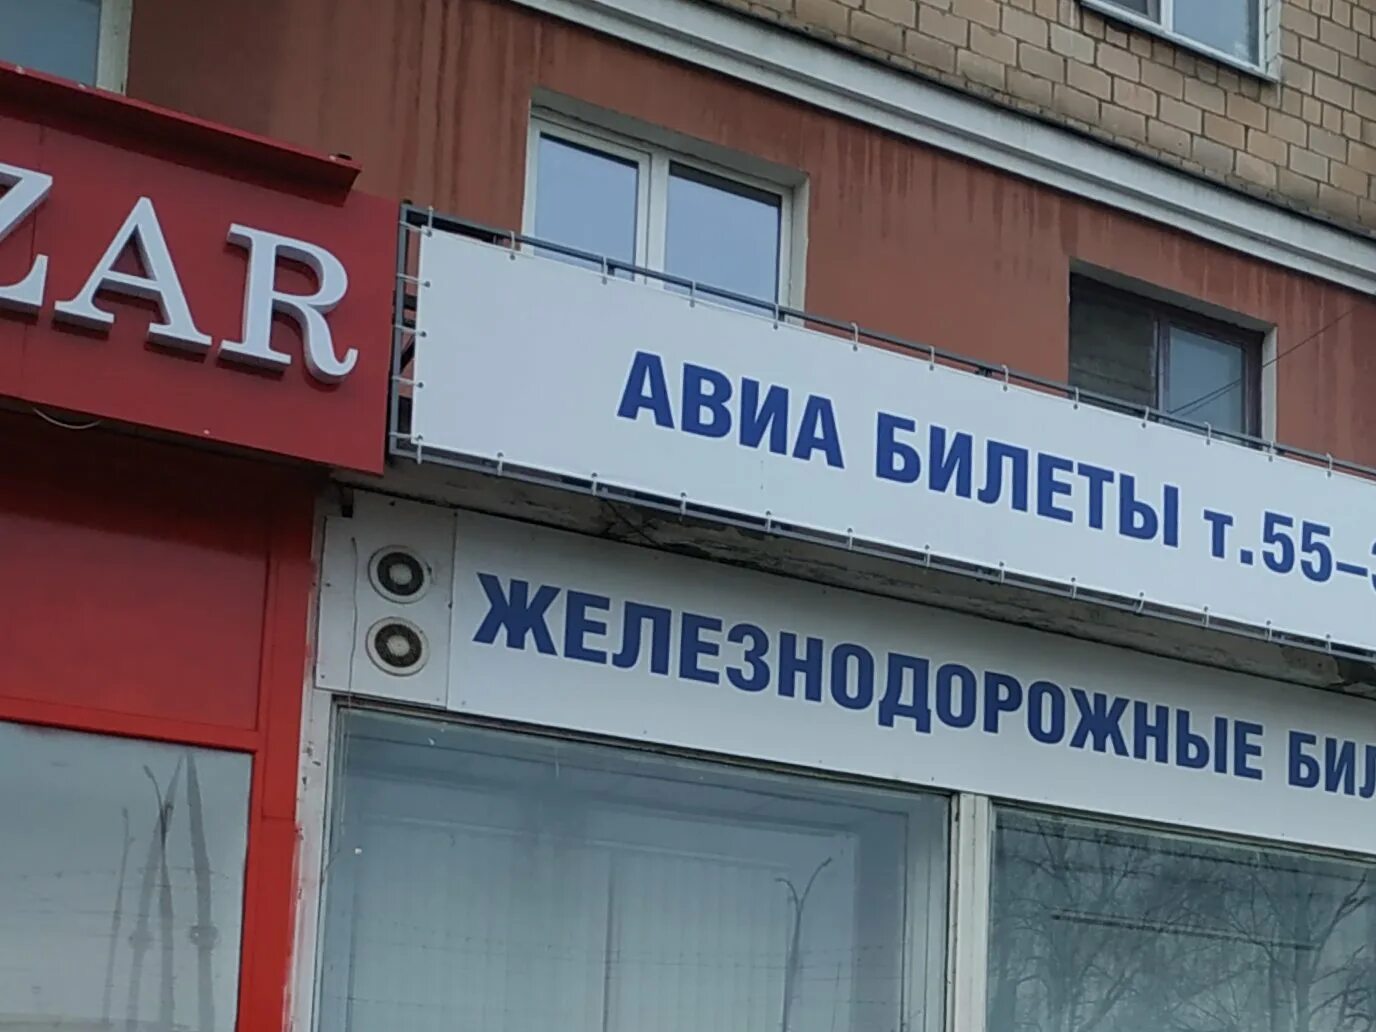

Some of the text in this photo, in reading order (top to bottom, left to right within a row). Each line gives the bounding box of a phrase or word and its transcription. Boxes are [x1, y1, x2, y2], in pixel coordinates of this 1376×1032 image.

[617, 350, 845, 470] АВИА
[875, 410, 1180, 548] БИЛЕТЫ
[473, 571, 1264, 781] ЖЕЛЕЗНОДОРОЖНЫЕ
